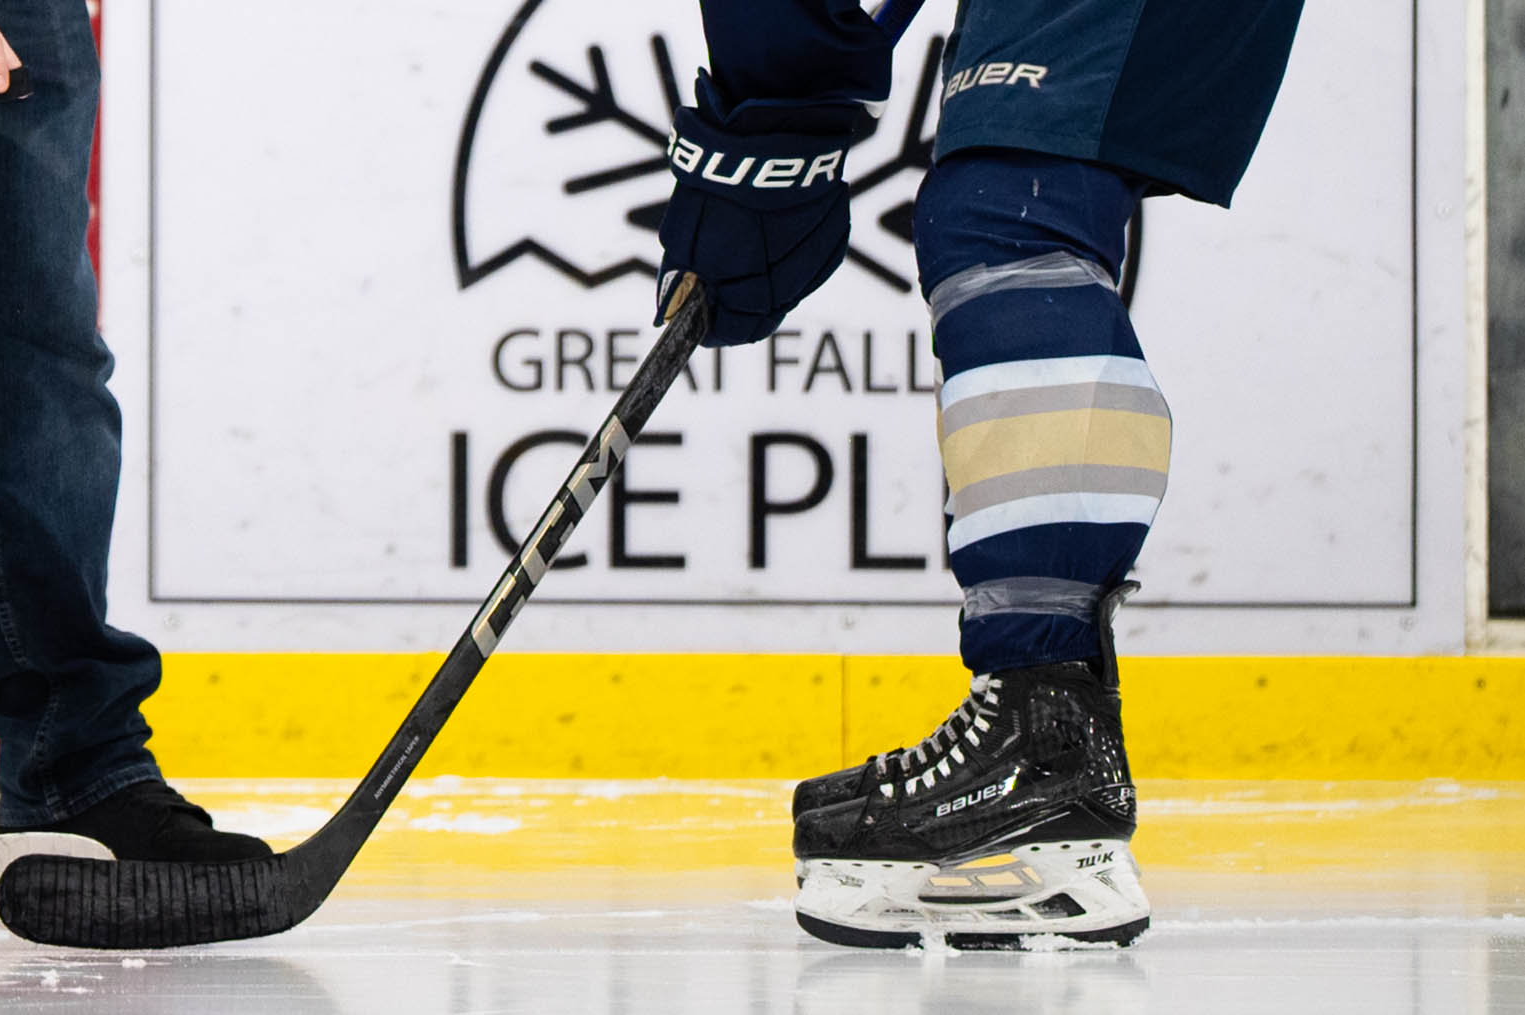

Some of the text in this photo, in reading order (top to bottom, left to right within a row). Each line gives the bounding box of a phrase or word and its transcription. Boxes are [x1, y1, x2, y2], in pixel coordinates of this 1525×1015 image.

[942, 62, 1048, 105] AUER
[767, 329, 935, 394] FALL
[450, 429, 950, 570] ICE PL
[471, 414, 632, 659] CCM
[935, 779, 1014, 817] BAUE
